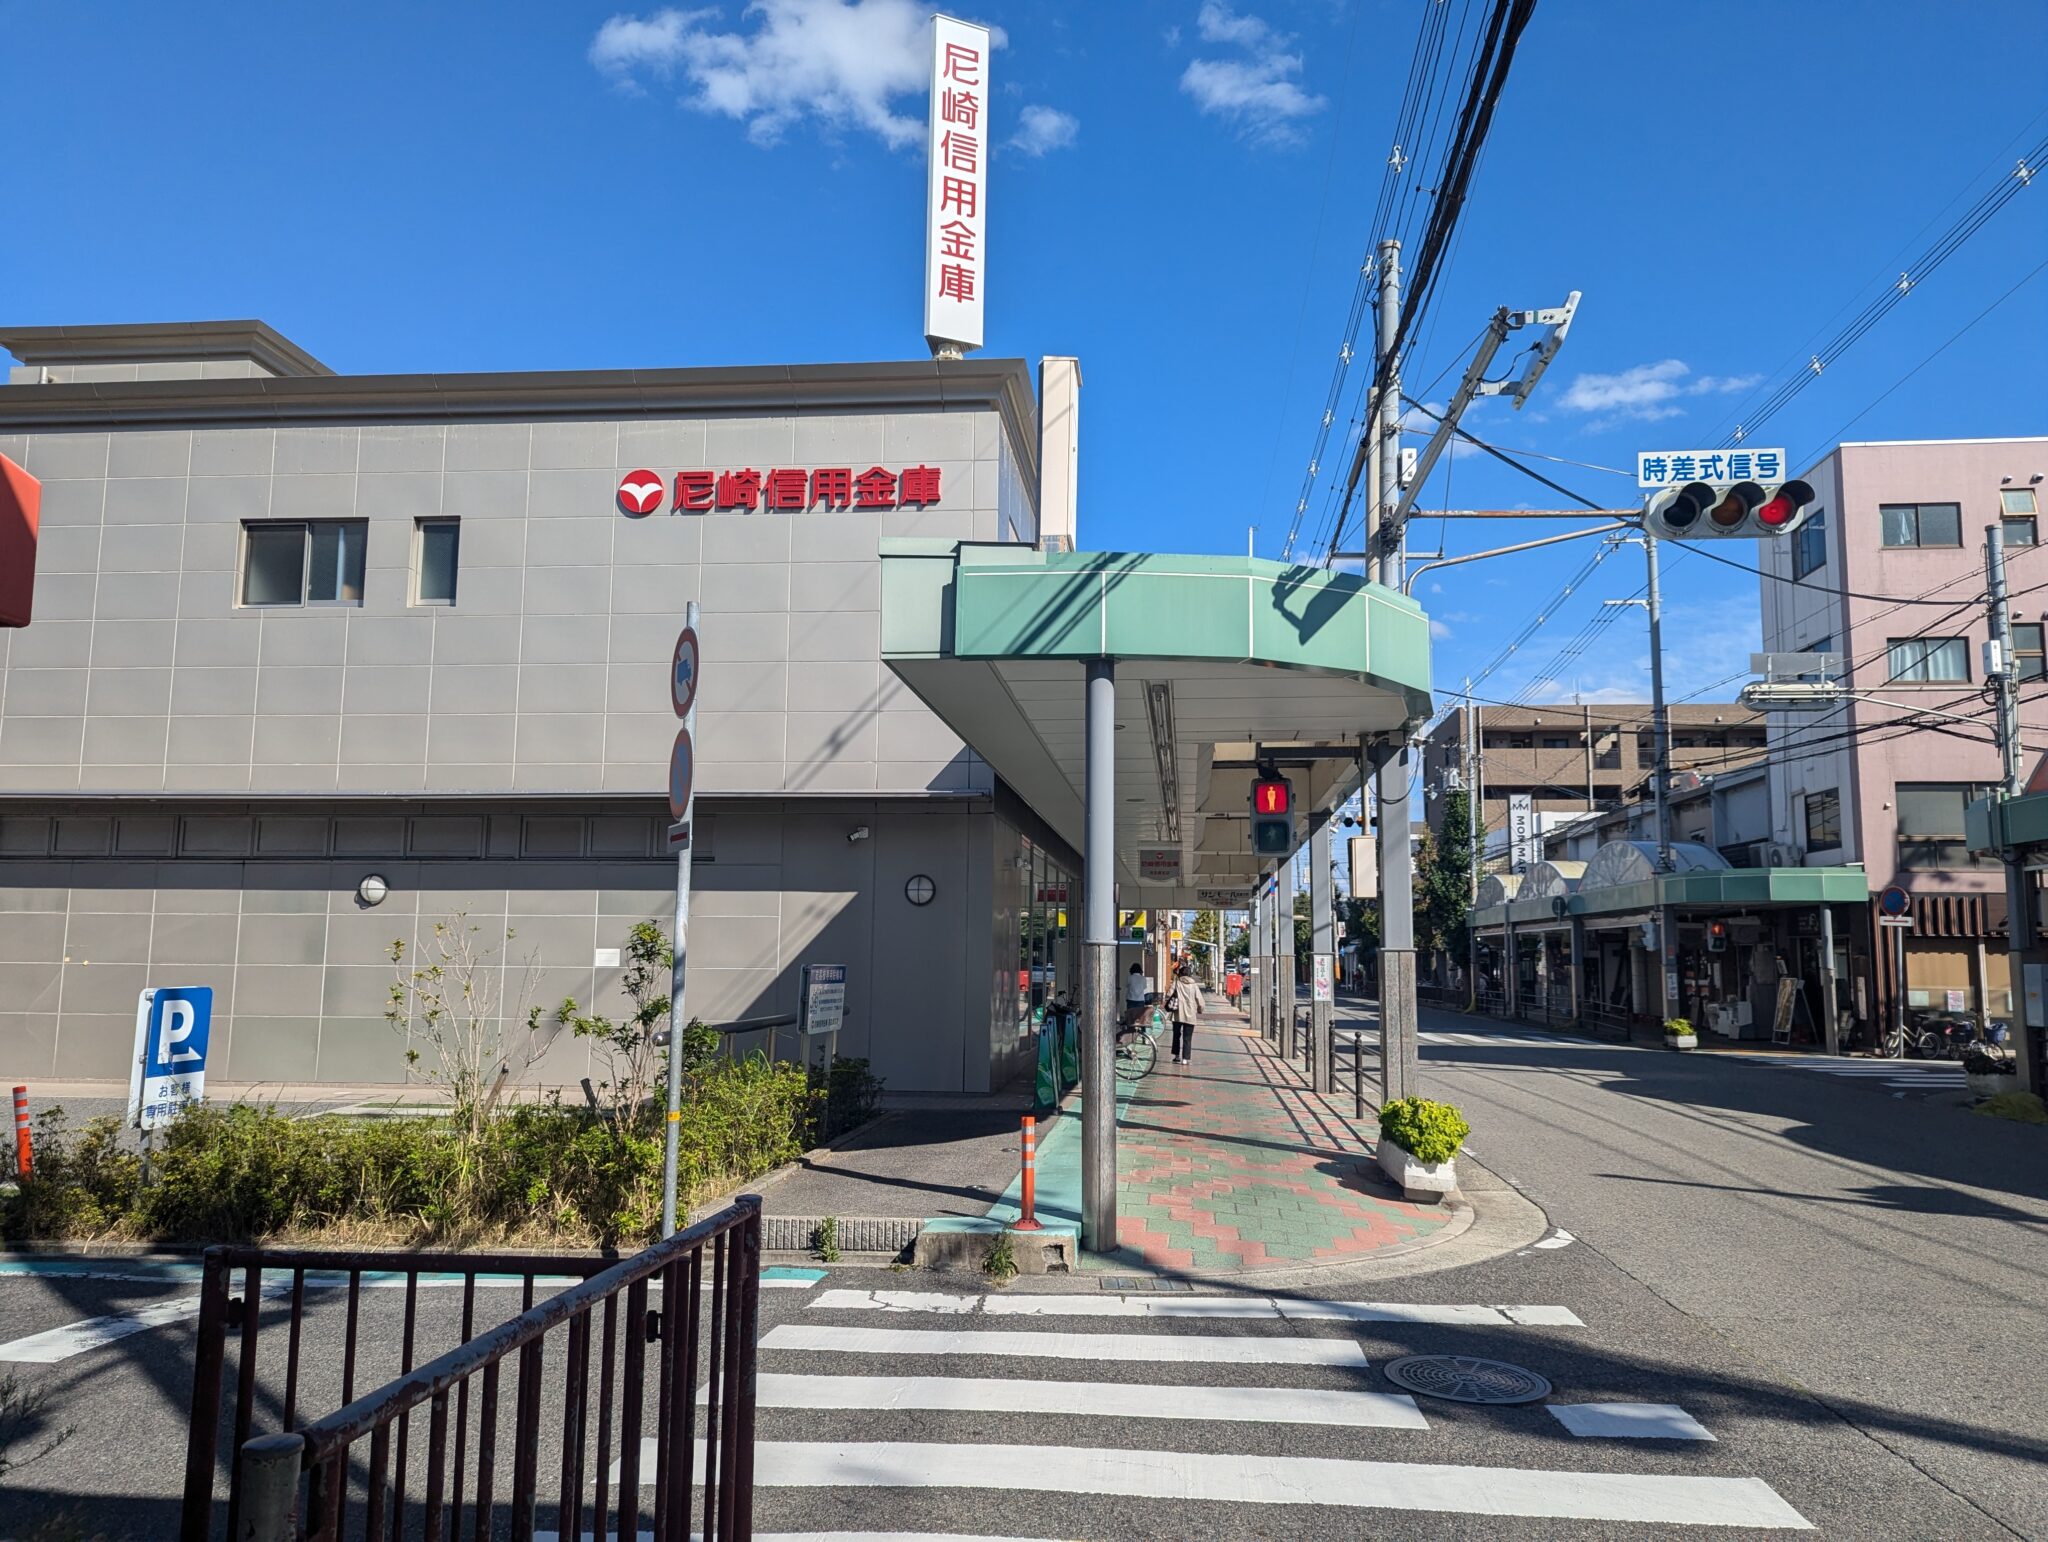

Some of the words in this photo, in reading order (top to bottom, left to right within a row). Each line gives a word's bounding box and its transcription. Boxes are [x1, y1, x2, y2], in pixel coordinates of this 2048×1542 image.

[939, 42, 979, 303] 尼崎信用金庫
[674, 465, 942, 509] 尼崎信用金庫
[1643, 453, 1780, 482] 時差式信号
[158, 1000, 195, 1065] P
